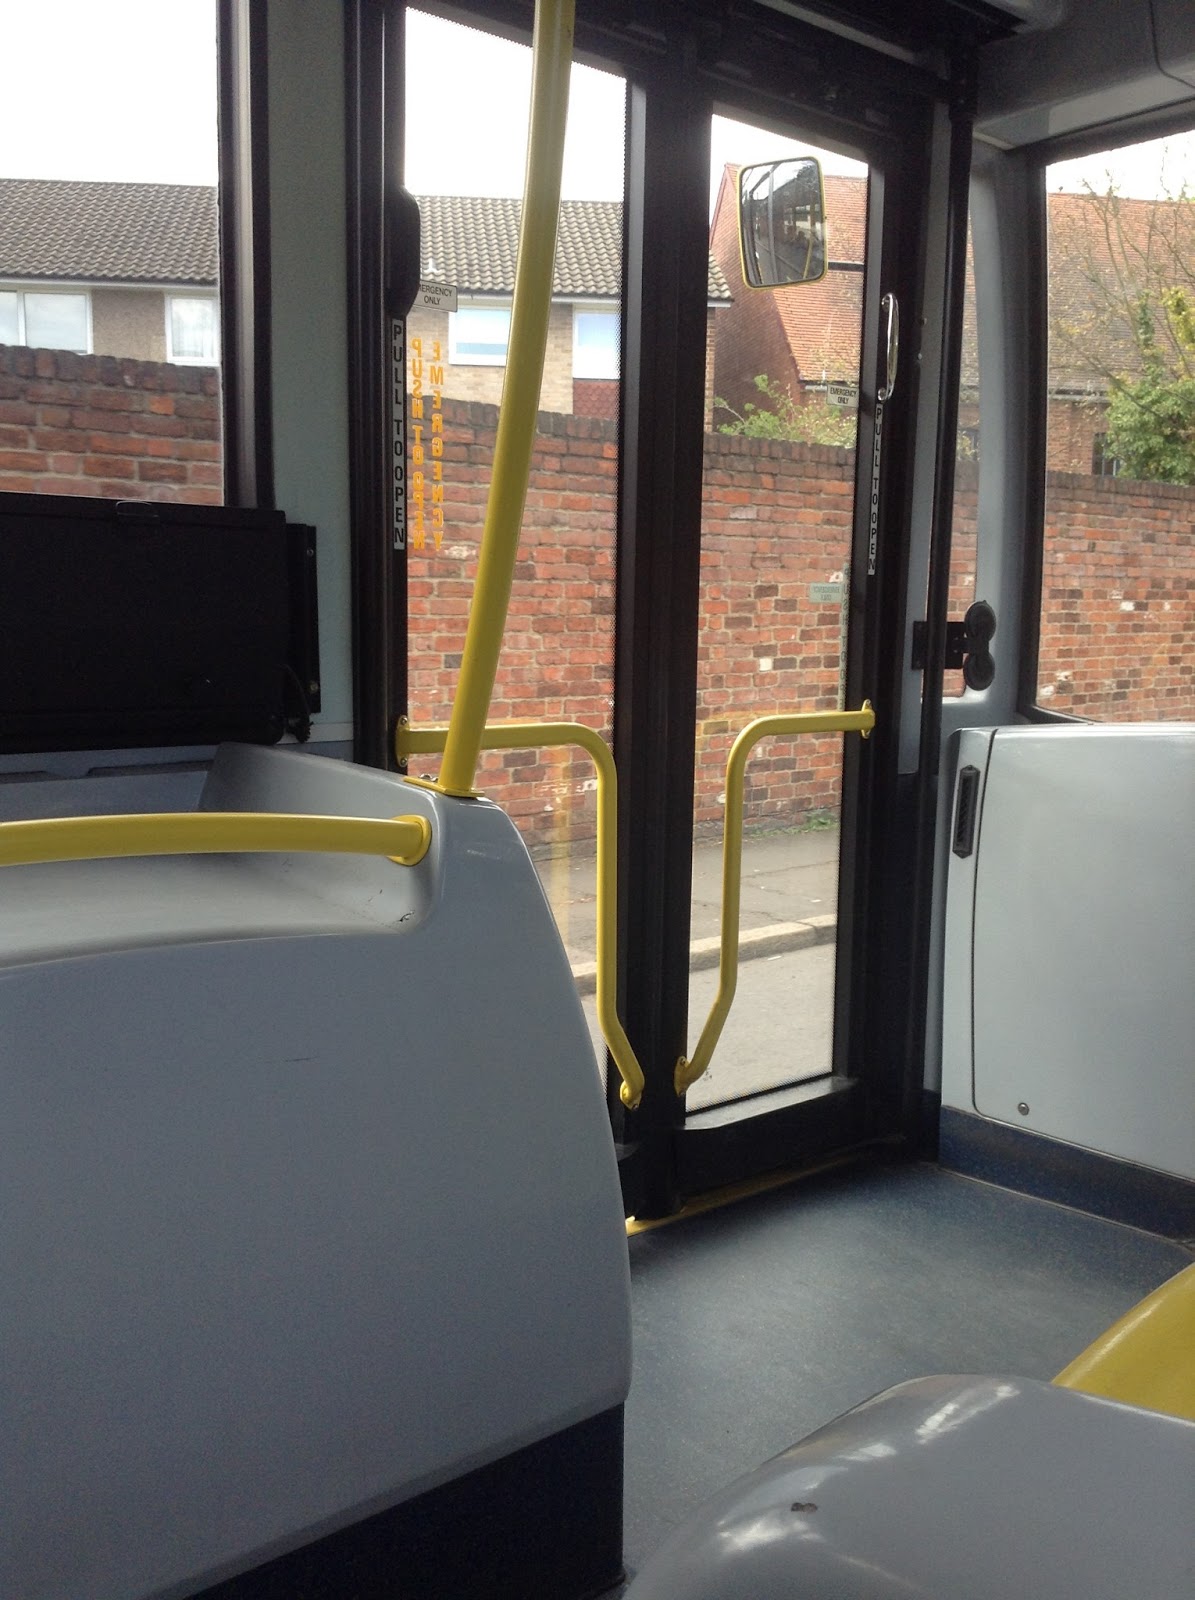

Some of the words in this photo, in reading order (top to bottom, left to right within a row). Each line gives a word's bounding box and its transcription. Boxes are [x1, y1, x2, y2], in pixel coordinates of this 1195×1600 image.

[420, 284, 453, 297] ERGENCY
[423, 295, 441, 305] ONLY
[393, 324, 403, 405] PULL
[829, 387, 857, 397] EMERGENCY
[837, 396, 849, 404] ONLY
[394, 419, 403, 456] TO
[874, 407, 882, 468] PULL
[394, 465, 404, 543] OPEN
[872, 477, 879, 506] TO
[869, 512, 878, 570] OPEN
